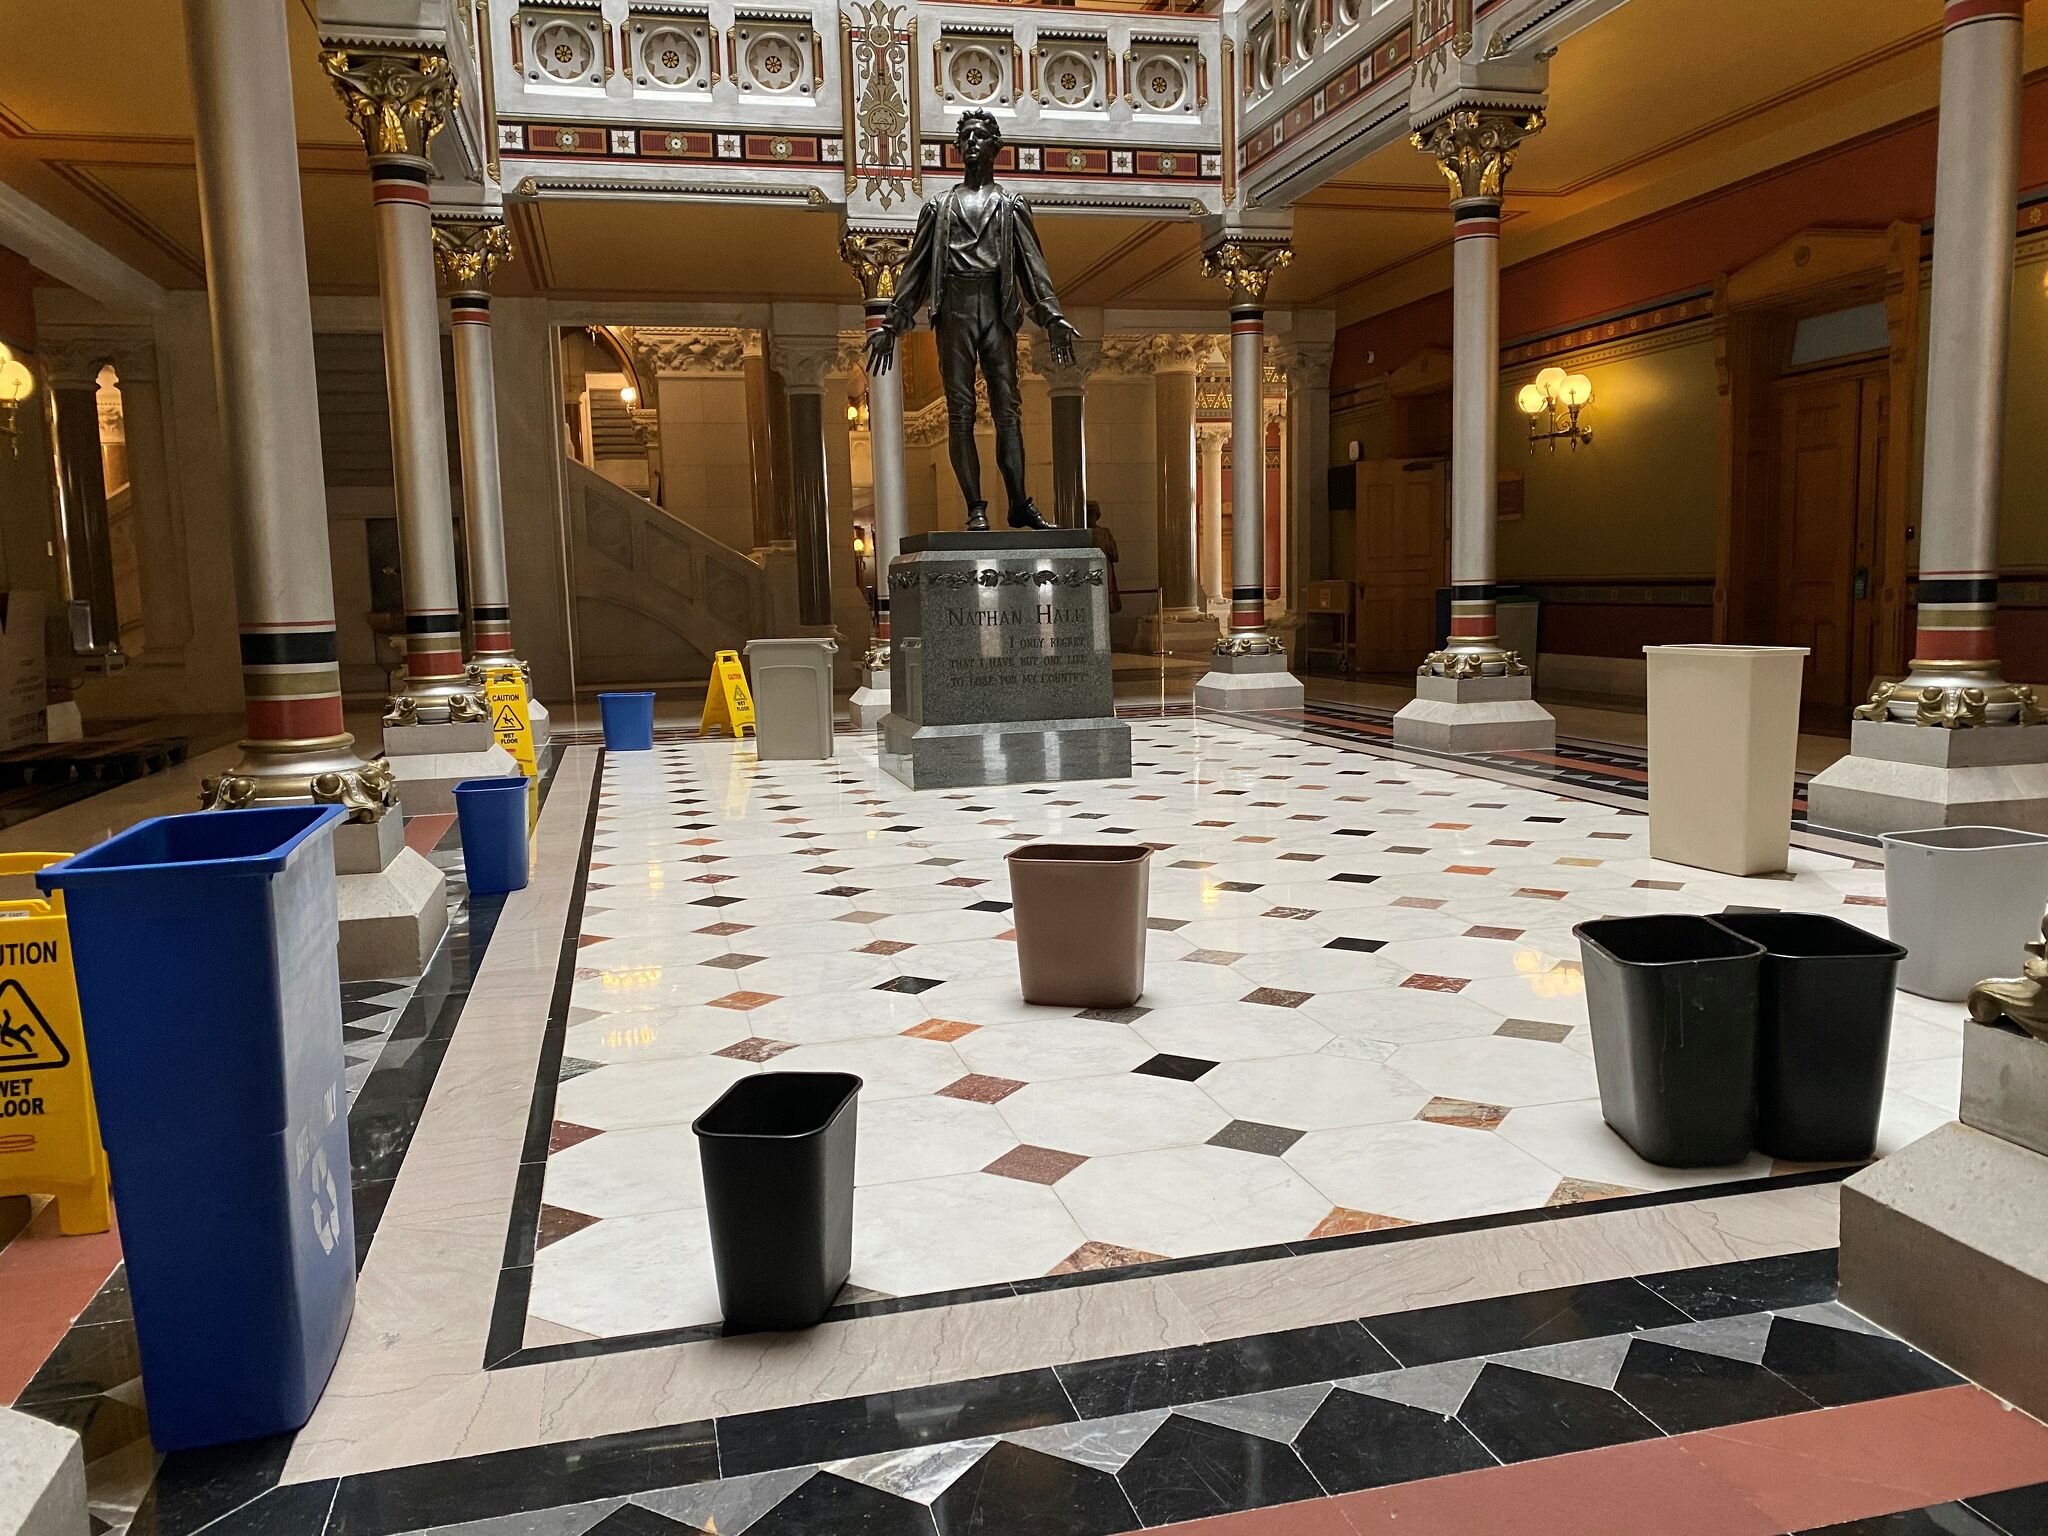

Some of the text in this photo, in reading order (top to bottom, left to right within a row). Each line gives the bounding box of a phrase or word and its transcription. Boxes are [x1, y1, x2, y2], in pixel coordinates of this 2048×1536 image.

[1020, 637, 1044, 648] ONLY
[1050, 637, 1085, 648] REGRET
[989, 656, 1015, 668] HAVE
[1020, 656, 1039, 666] BUT
[1043, 655, 1061, 665] ONE
[728, 673, 742, 681] CAUTION
[950, 677, 964, 687] TO
[1022, 674, 1037, 684] MY
[492, 694, 520, 702] CAUTION
